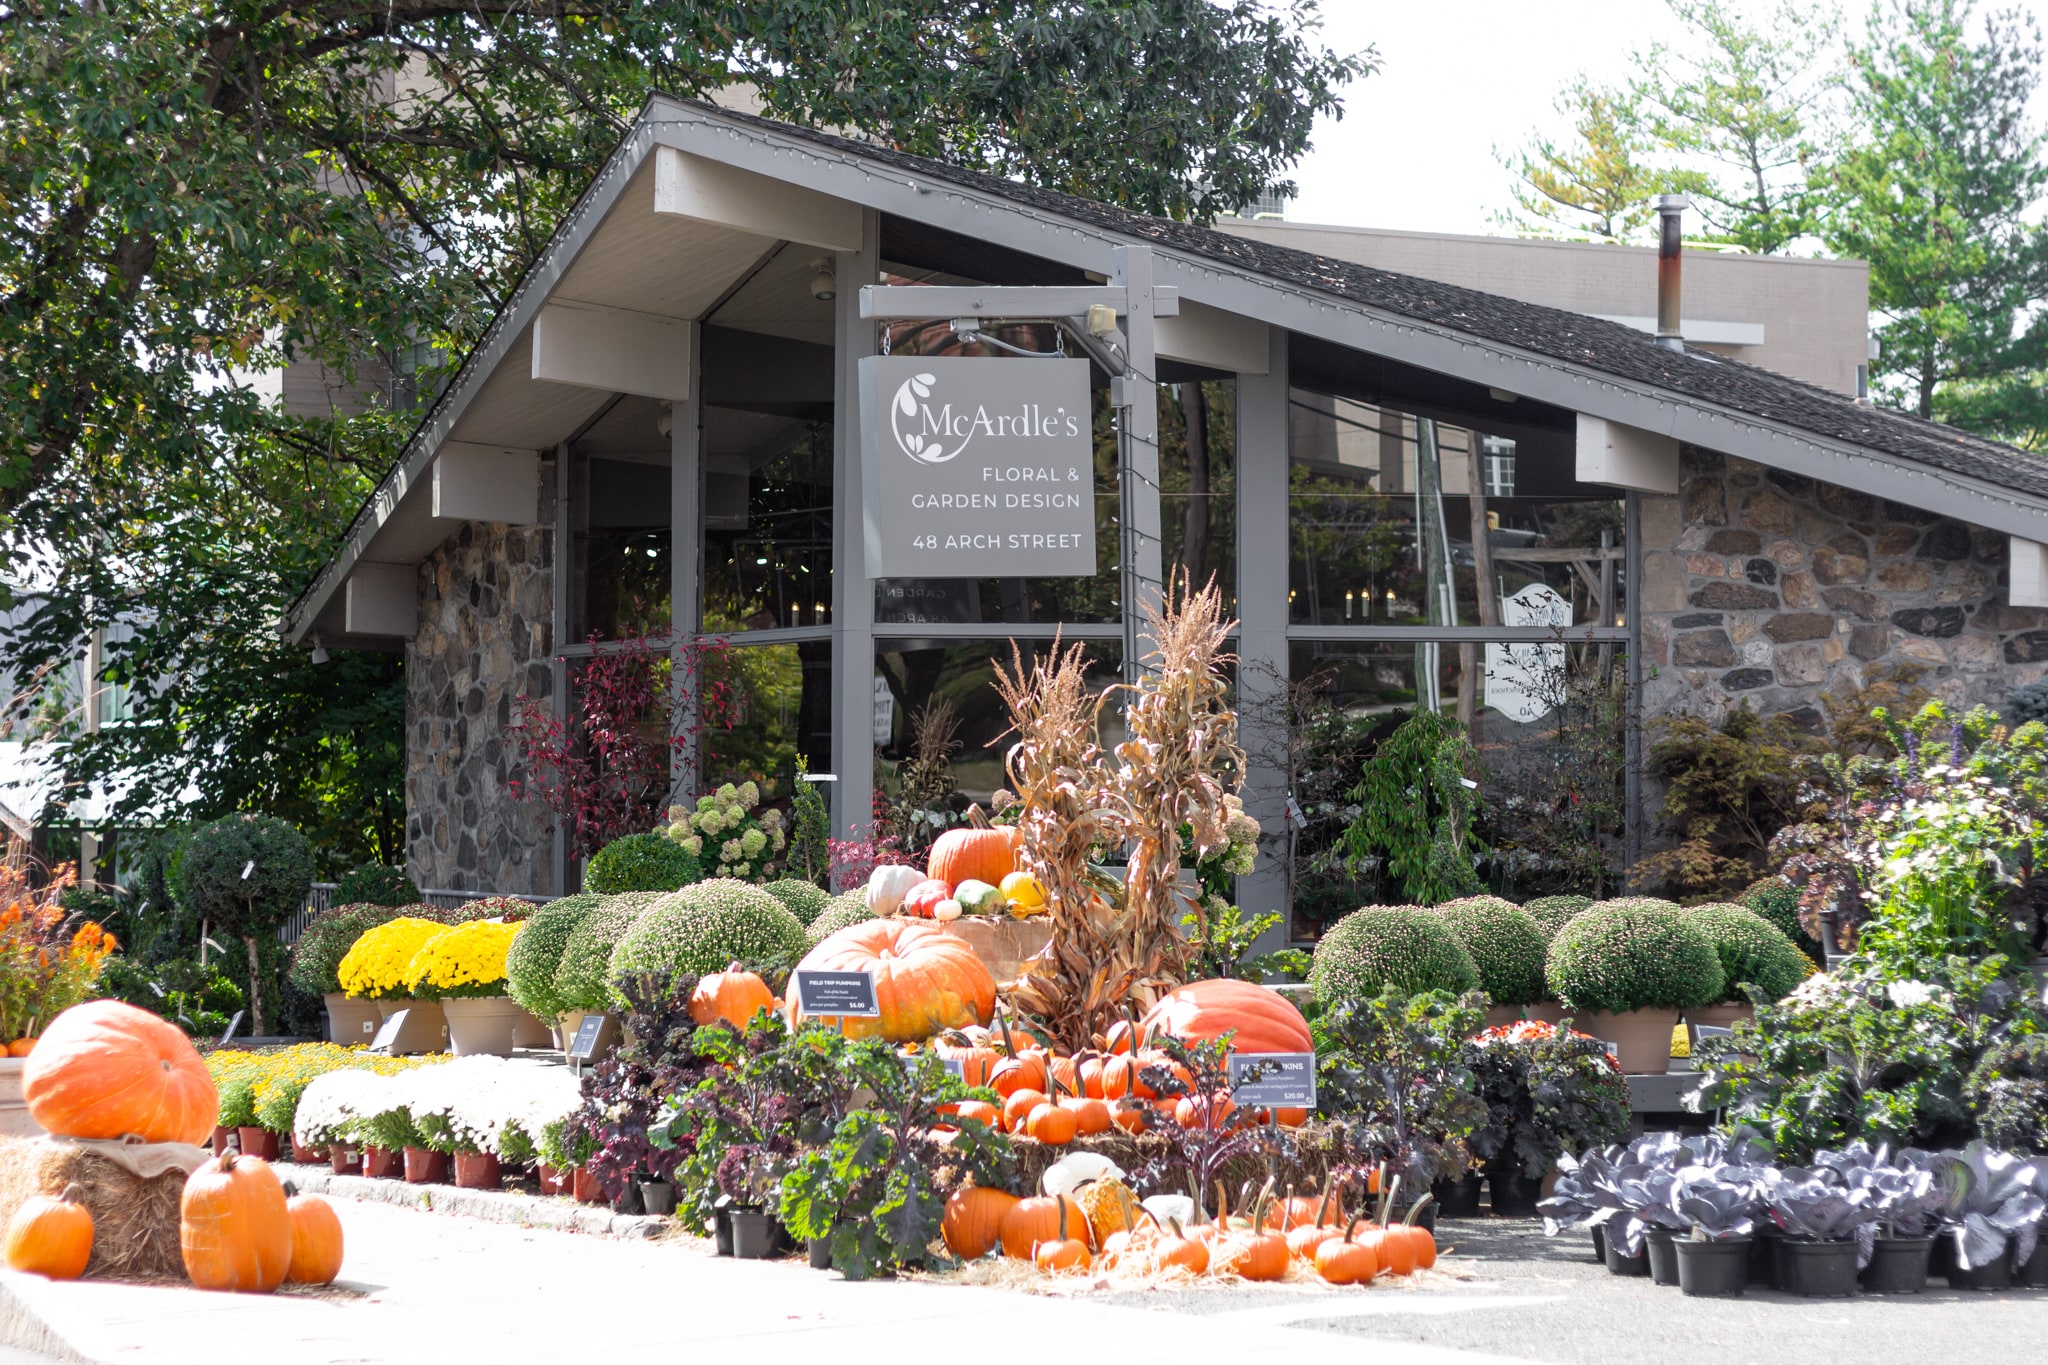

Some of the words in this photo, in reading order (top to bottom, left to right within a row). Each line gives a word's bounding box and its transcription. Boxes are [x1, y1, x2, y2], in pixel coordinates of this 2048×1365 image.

[920, 403, 1078, 437] McArdle's
[983, 467, 1060, 482] FLORAL
[1067, 467, 1080, 481] &
[911, 494, 997, 508] GARDEN
[1005, 494, 1080, 508] DESIGN
[913, 534, 938, 549] 48
[945, 534, 1001, 549] ARCH
[1008, 533, 1082, 548] STREET
